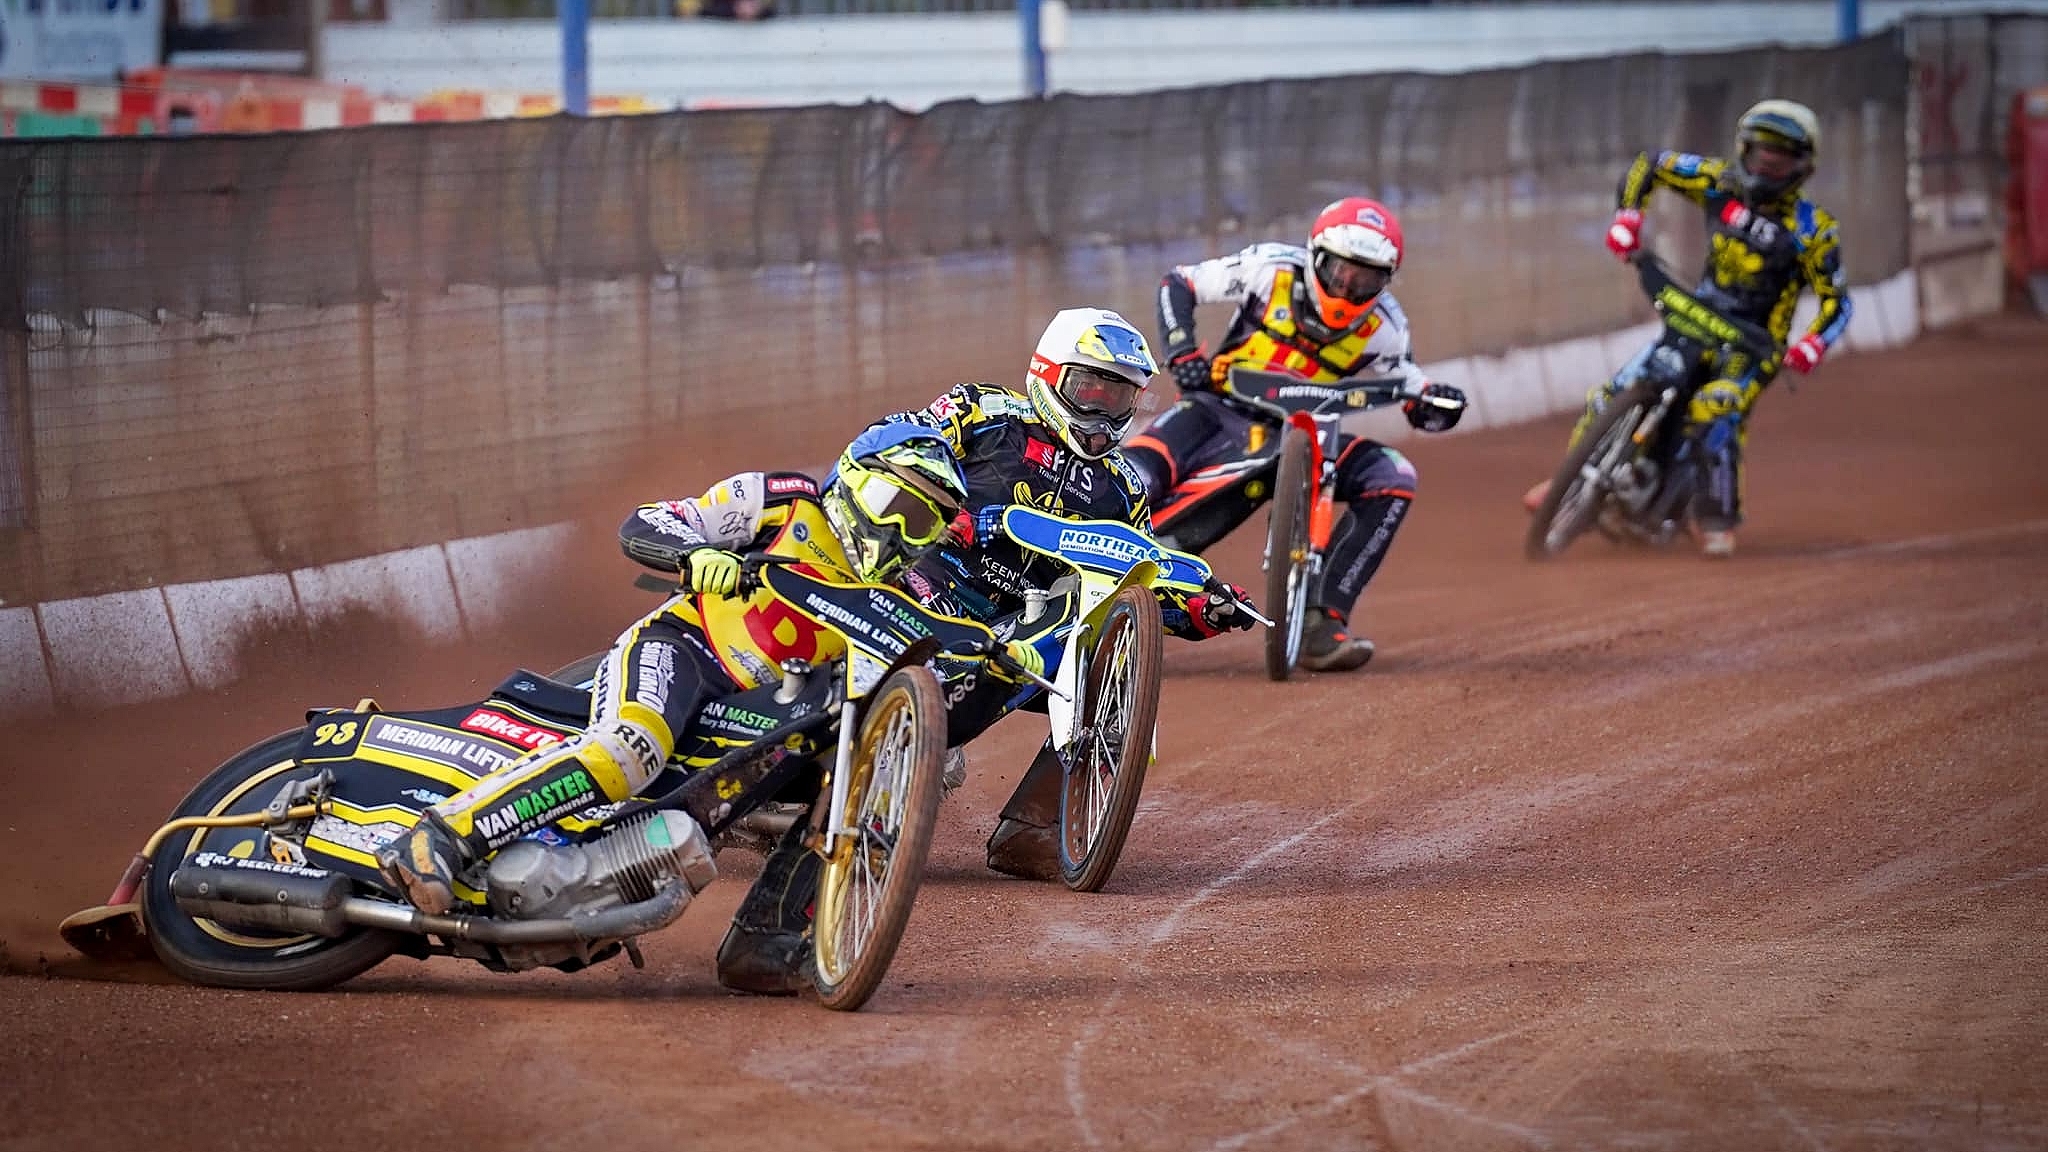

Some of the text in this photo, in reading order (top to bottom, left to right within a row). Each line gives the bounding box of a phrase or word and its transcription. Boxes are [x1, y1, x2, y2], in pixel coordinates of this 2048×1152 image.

[1065, 481, 1092, 504] Services
[1061, 544, 1104, 555] DEMOLITION
[806, 593, 907, 655] MERIDIAN LIFTS
[868, 589, 933, 636] VAN MAST
[467, 713, 558, 748] BIKE IT
[702, 702, 778, 729] AN MASTER
[376, 724, 464, 756] MERIDIAN
[488, 828, 520, 850] Bury
[537, 791, 595, 820] Edmunds
